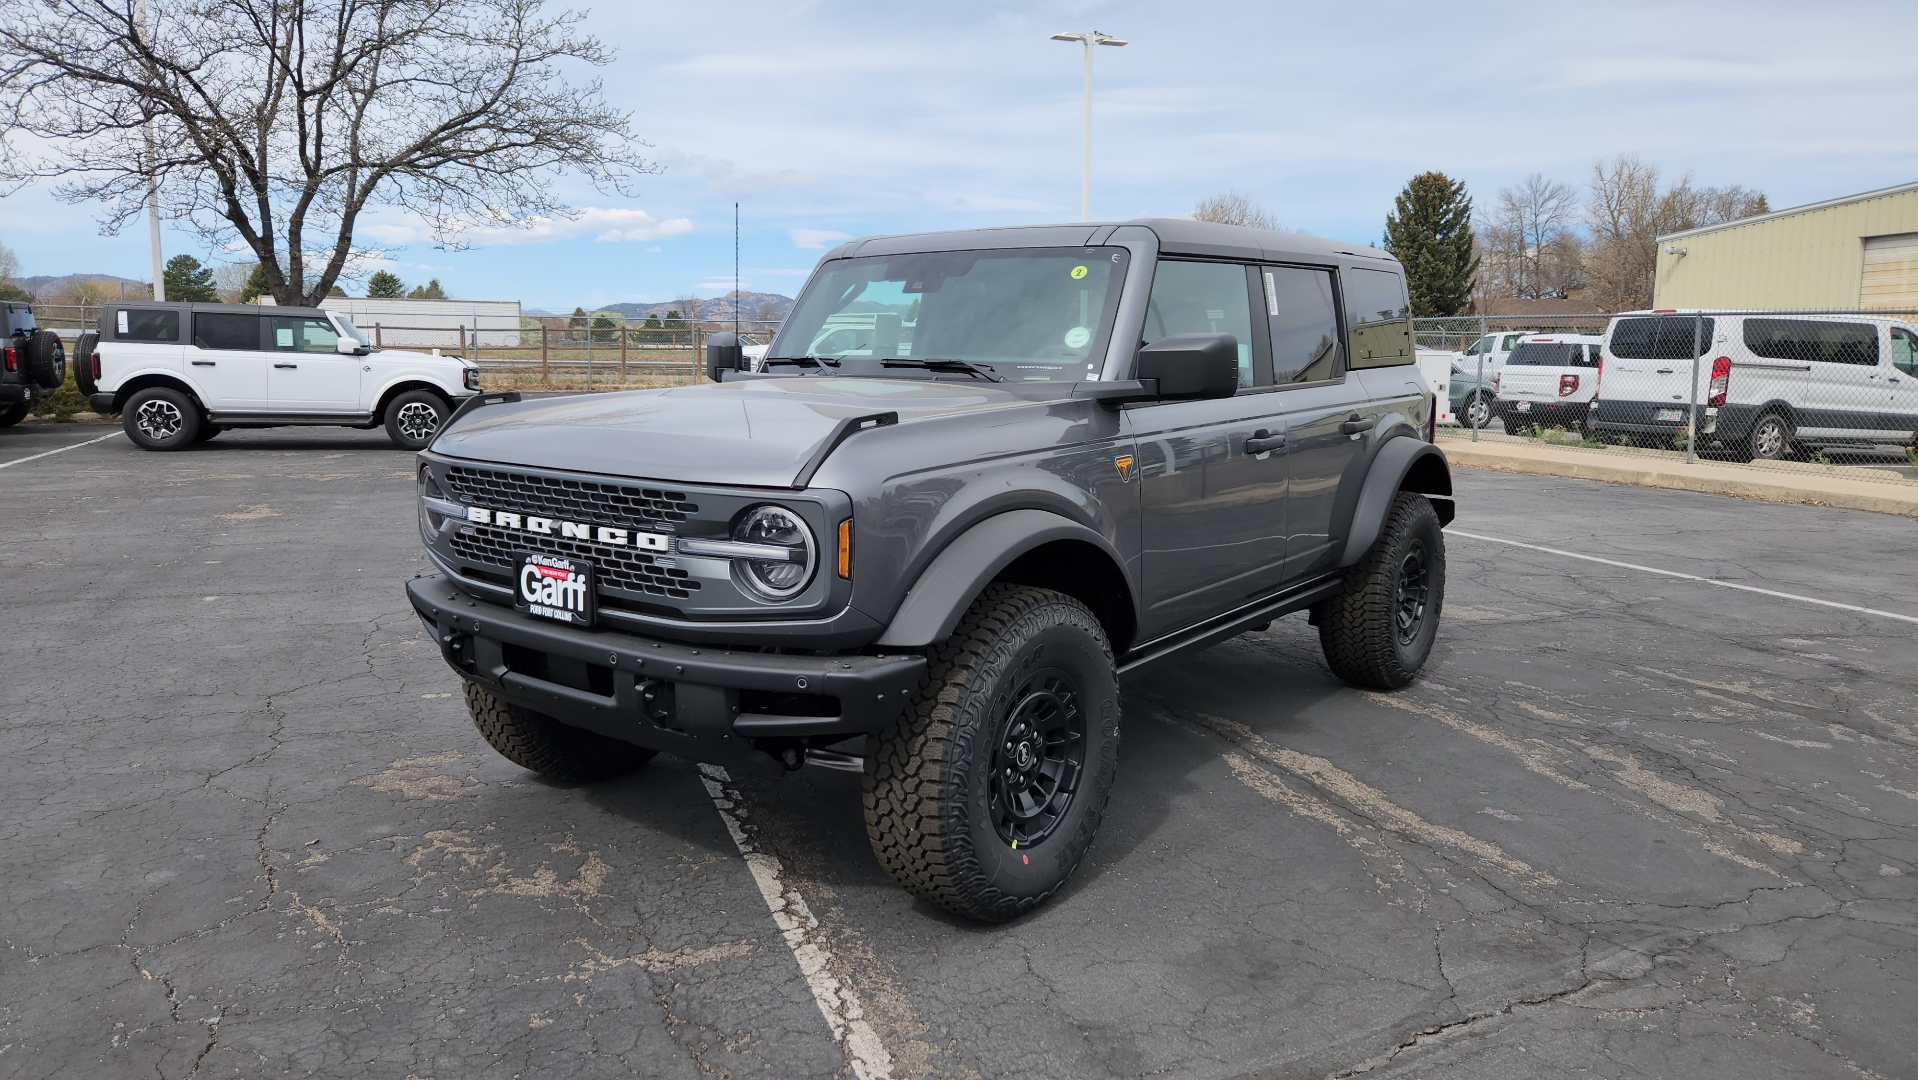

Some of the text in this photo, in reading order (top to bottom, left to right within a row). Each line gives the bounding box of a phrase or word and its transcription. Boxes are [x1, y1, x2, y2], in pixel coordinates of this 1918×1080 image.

[1076, 268, 1082, 277] 2
[467, 506, 669, 551] BRONCO
[520, 564, 587, 612] Garff
[530, 604, 573, 622] FORD FORT COLLINS
